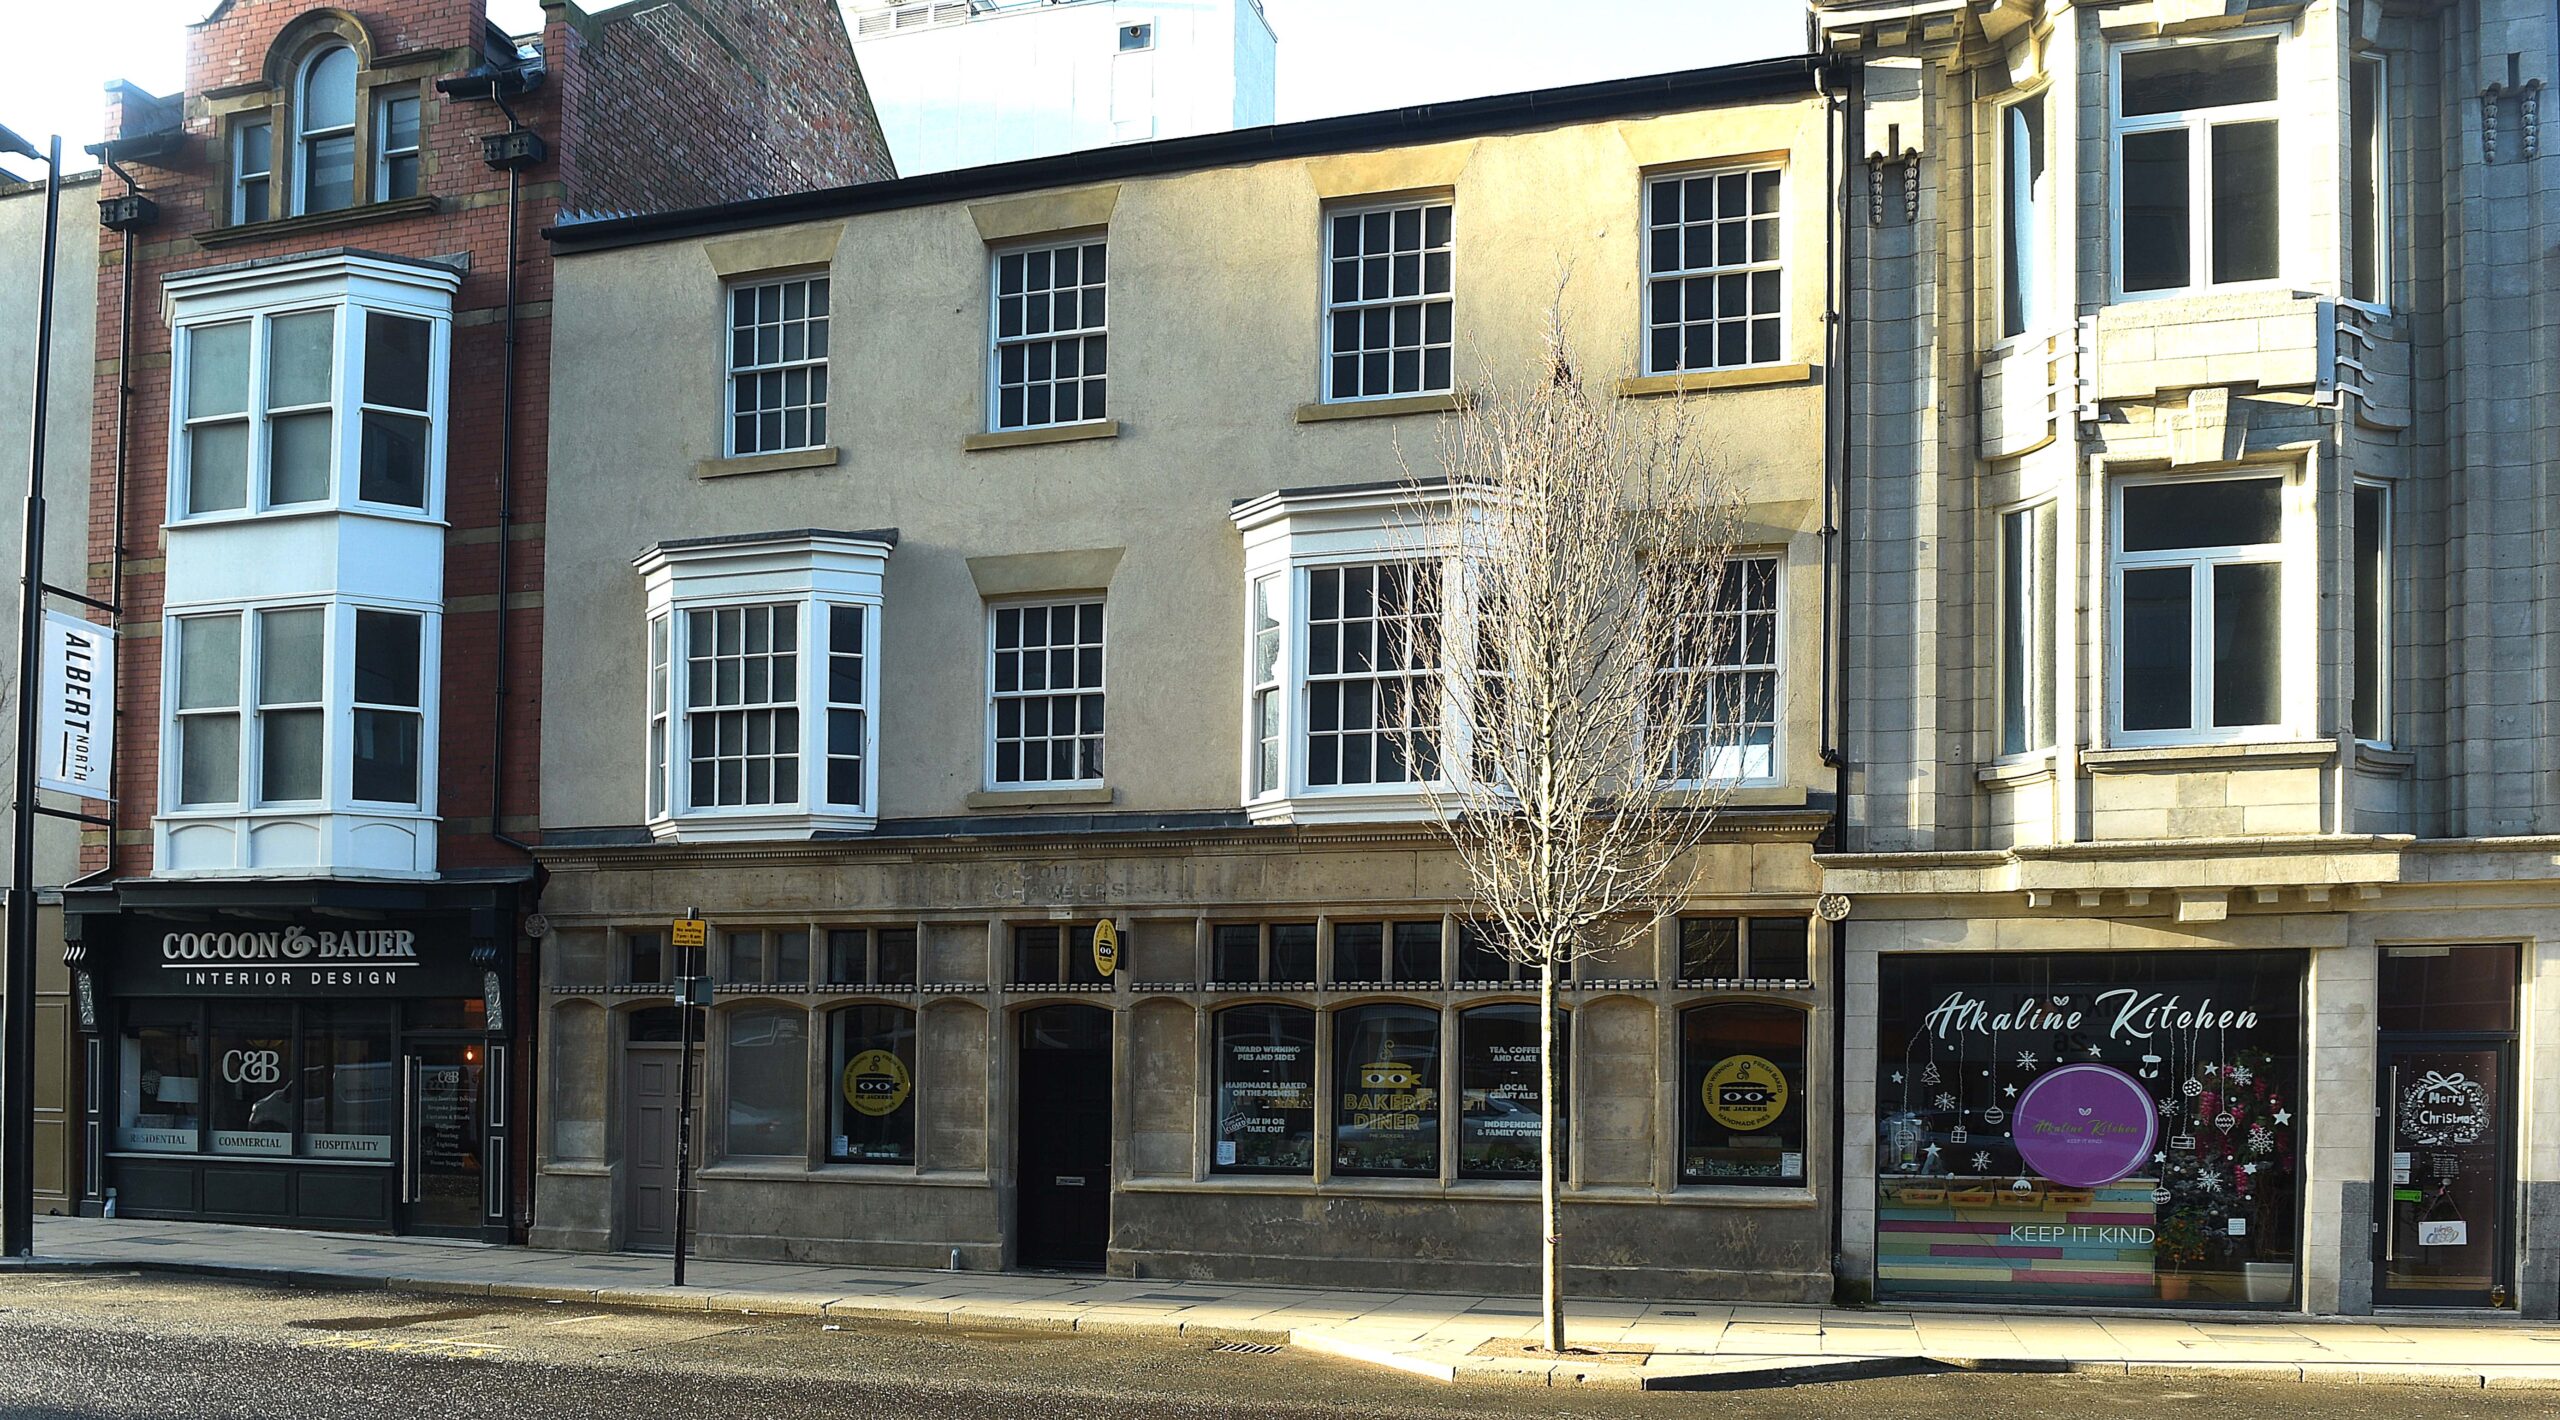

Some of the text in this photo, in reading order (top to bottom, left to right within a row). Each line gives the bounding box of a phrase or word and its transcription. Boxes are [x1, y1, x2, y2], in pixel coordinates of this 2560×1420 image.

[65, 632, 92, 733] ALBERT
[74, 734, 91, 781] NORTH
[186, 971, 396, 985] INTERIOR DESIGN
[1925, 988, 2258, 1039] Alkaline Kitchen
[1489, 1046, 1542, 1054] TEA, COFFEE
[222, 1050, 280, 1083] C&B
[438, 1071, 460, 1083] C&B
[1753, 1060, 1783, 1094] FRESH BAKED
[1233, 1089, 1300, 1097] ON THE PREMISES
[1489, 1092, 1539, 1100] CRAFT ALES
[2428, 1091, 2465, 1107] Merry
[1344, 1093, 1428, 1110] BAKERY
[1226, 1120, 1246, 1133] CLOSED
[1247, 1117, 1260, 1125] EAT
[1353, 1113, 1420, 1130] DINER
[1718, 1113, 1771, 1127] HANDMADE PIES
[1485, 1129, 1516, 1137] FAMILY
[2033, 1119, 2138, 1136] Alkaline Kitchen
[130, 1134, 187, 1145] RESIDENTIAL
[218, 1136, 282, 1148] COMMERCIAL
[314, 1140, 378, 1151] HOSPITALITY
[2010, 1226, 2156, 1244] KEEP IT KIND
